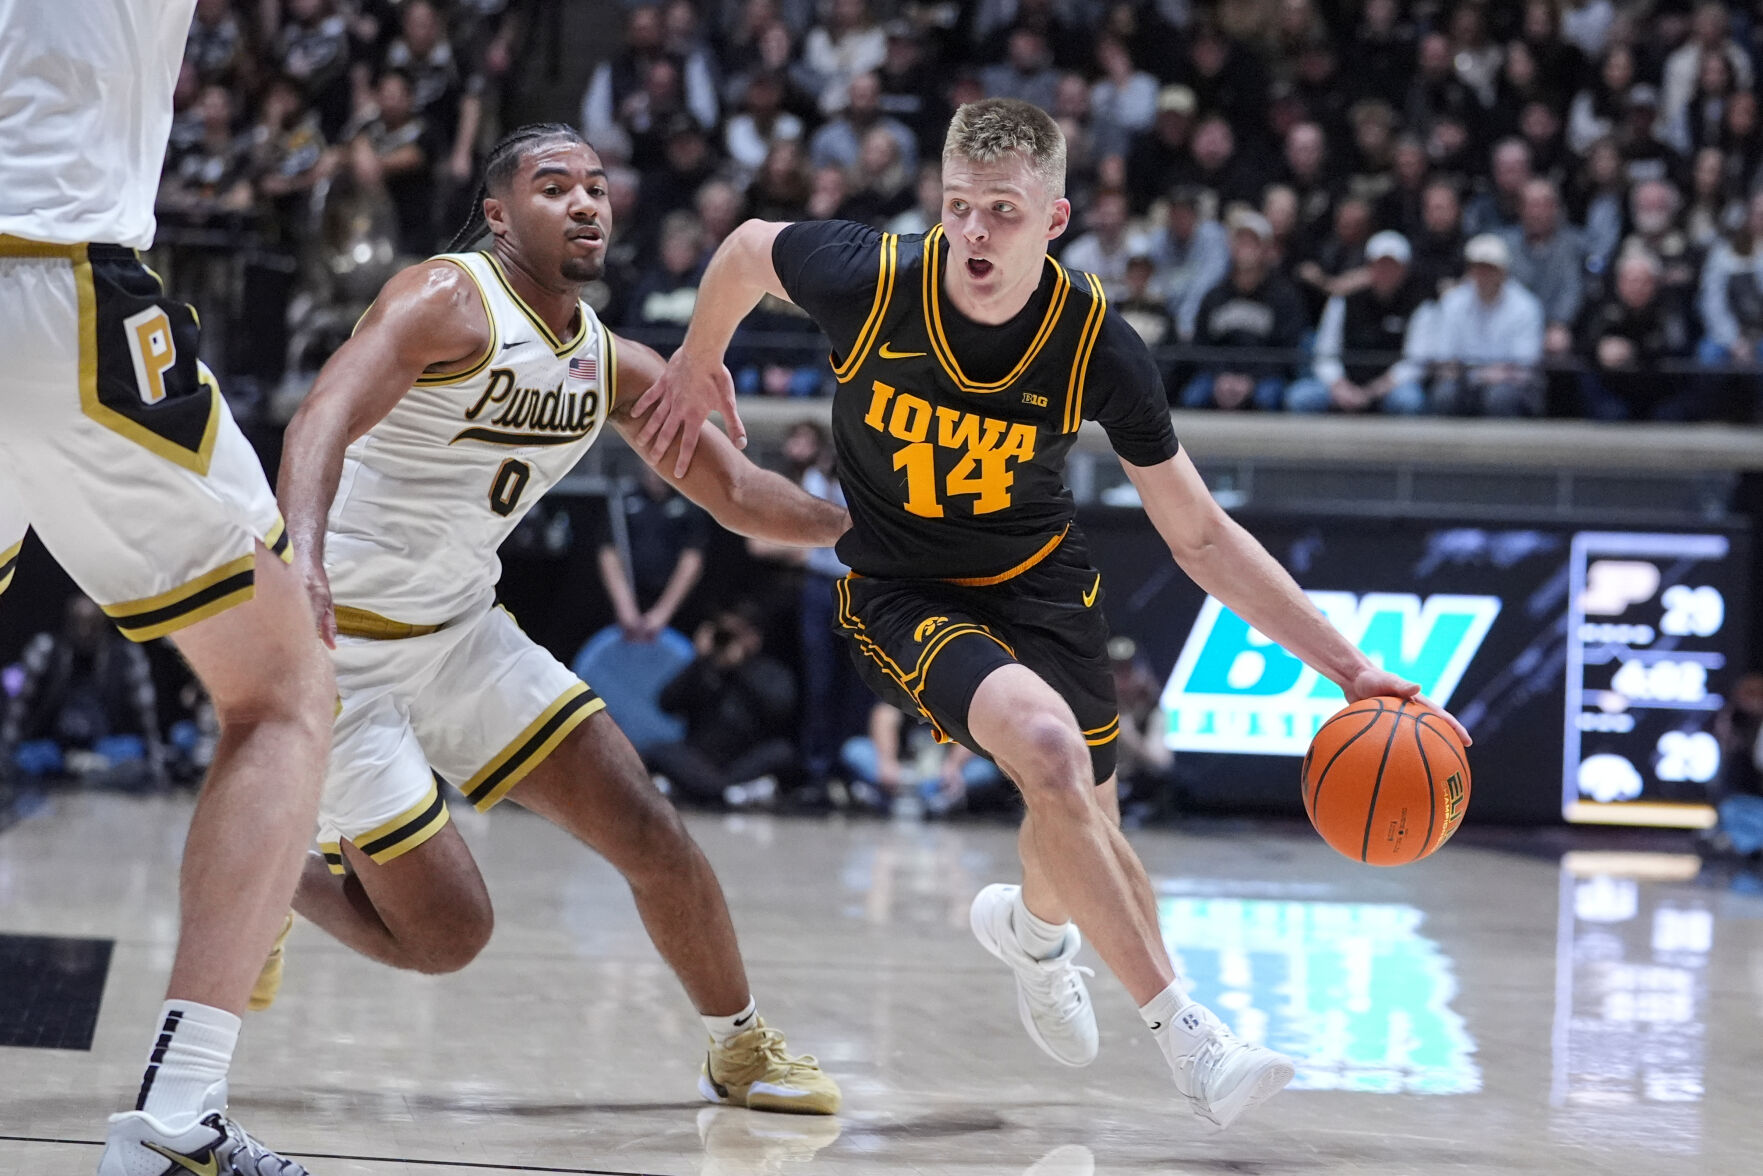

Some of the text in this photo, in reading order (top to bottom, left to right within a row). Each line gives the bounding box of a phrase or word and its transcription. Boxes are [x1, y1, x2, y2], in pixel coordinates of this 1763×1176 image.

[123, 304, 176, 405] P
[465, 367, 598, 433] Purdue
[864, 379, 1038, 464] IOWA
[488, 457, 530, 517] 0
[892, 442, 1014, 518] 14
